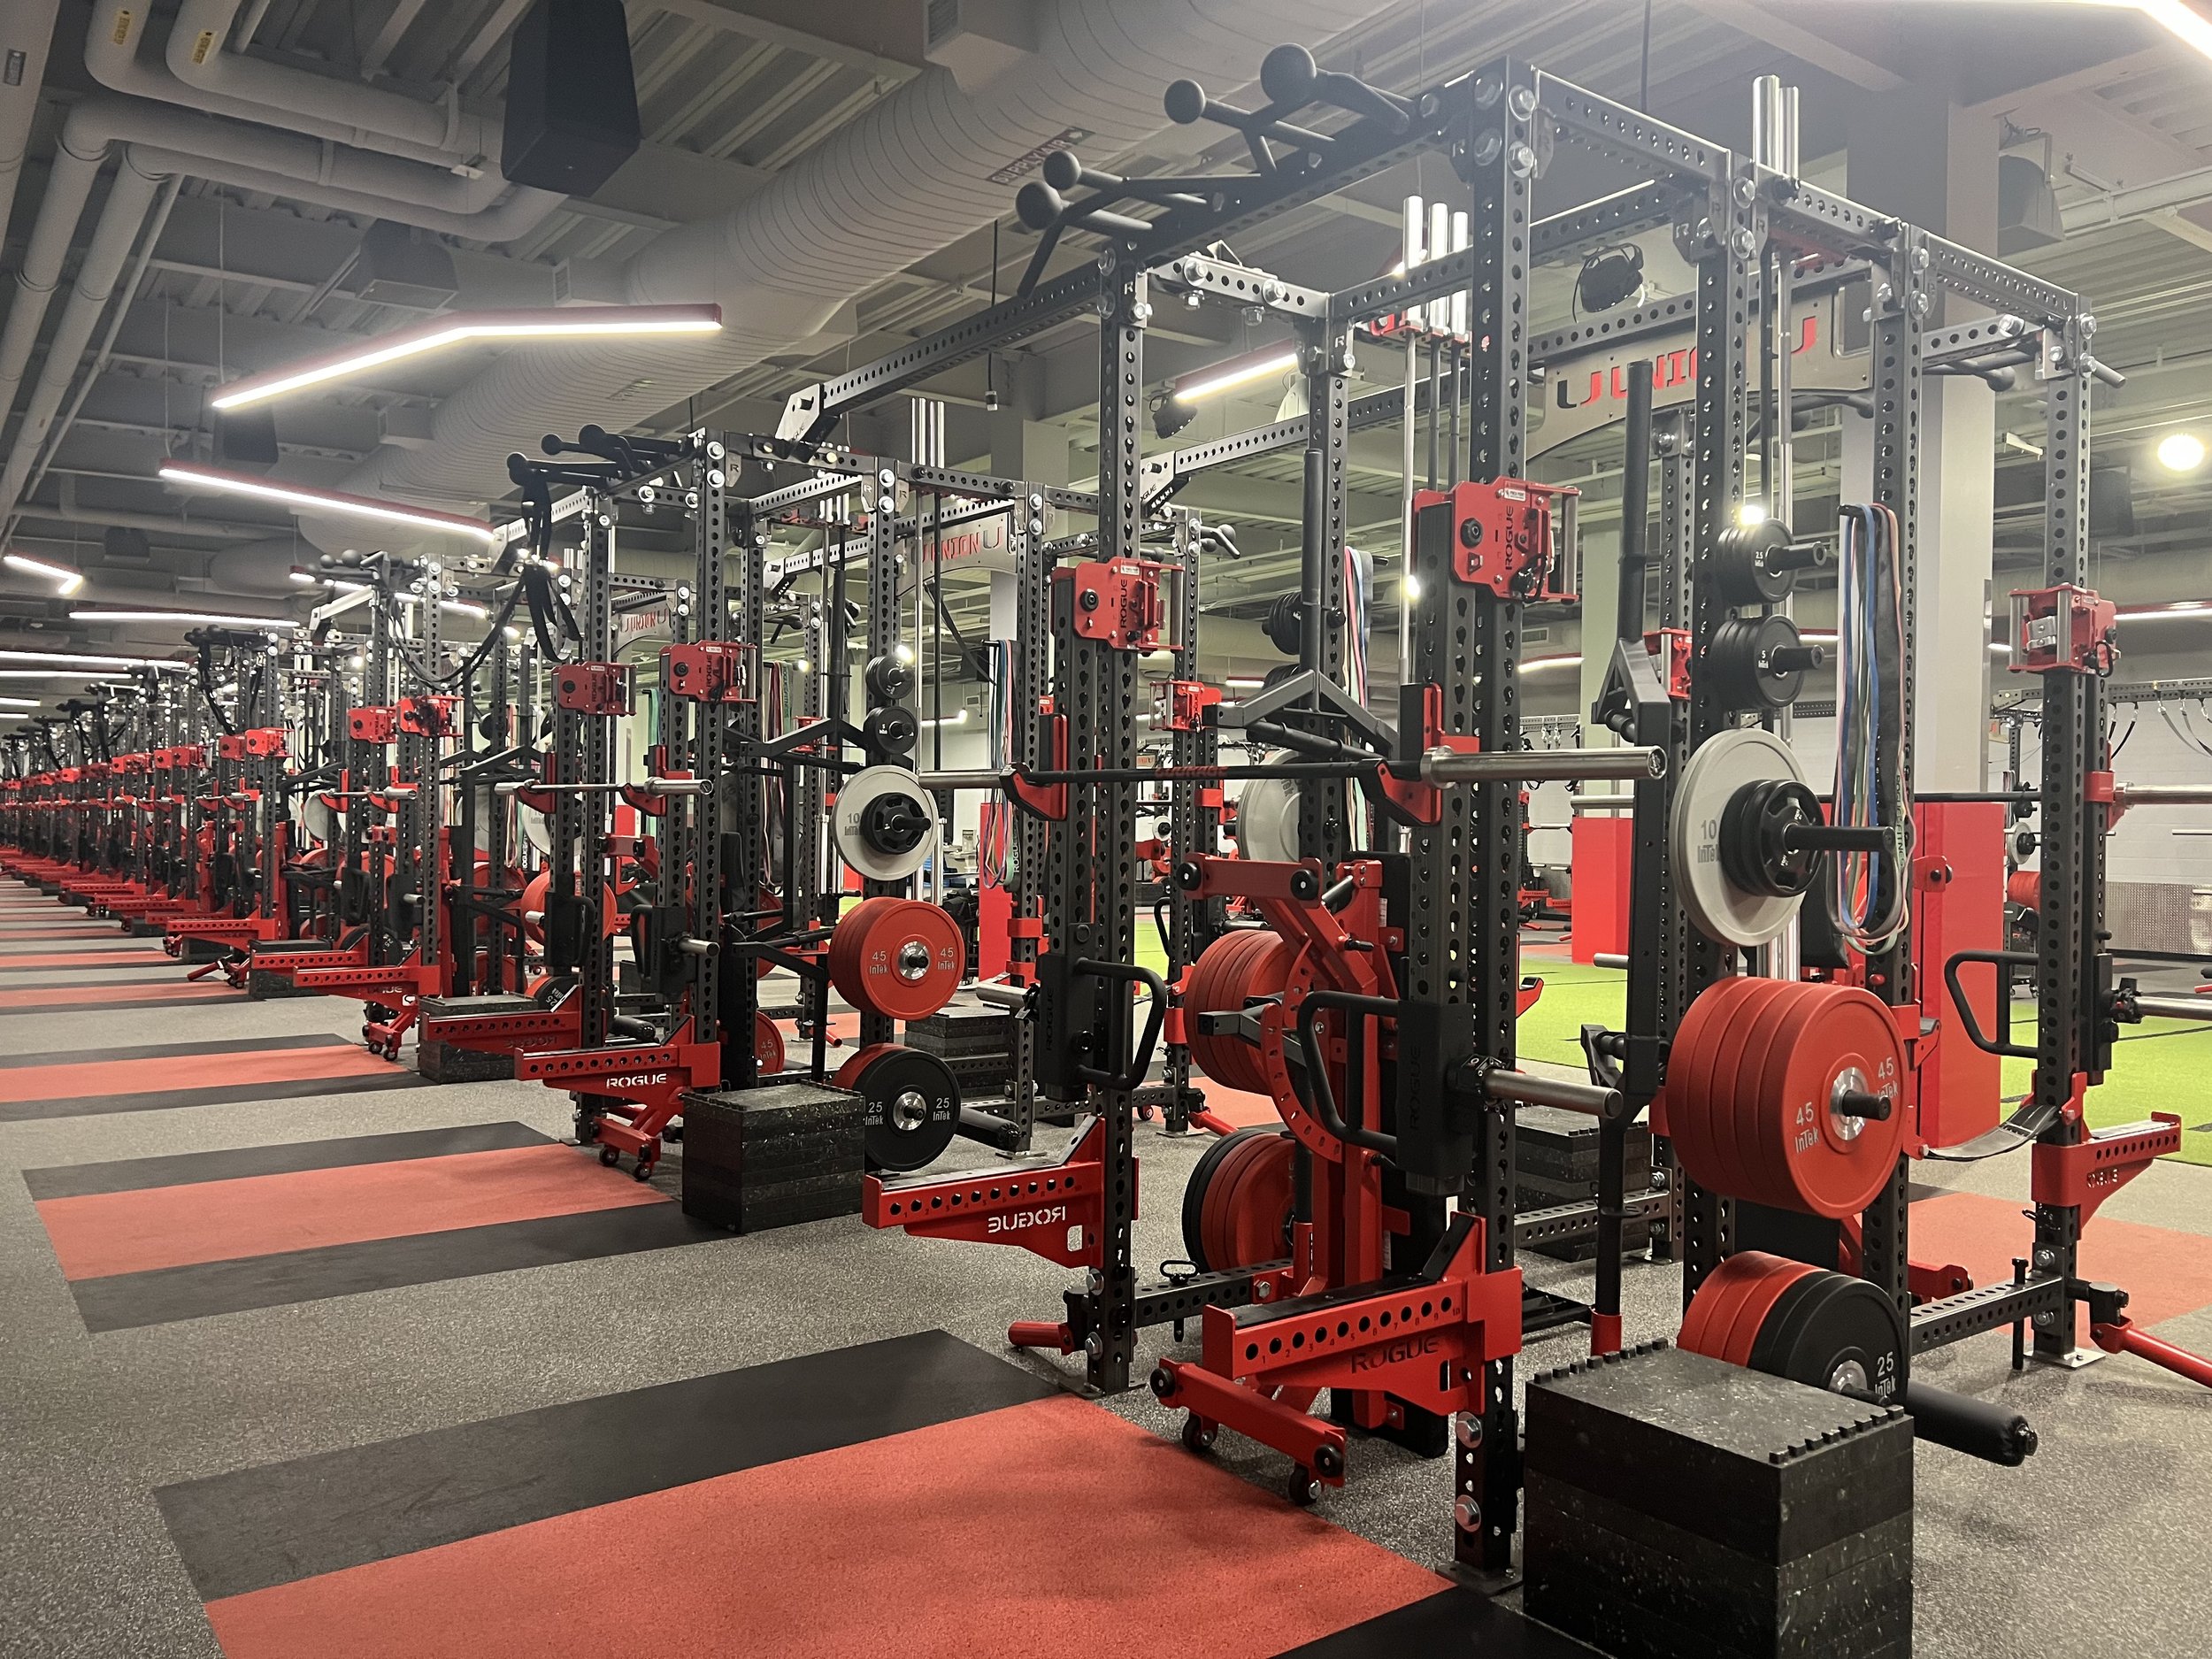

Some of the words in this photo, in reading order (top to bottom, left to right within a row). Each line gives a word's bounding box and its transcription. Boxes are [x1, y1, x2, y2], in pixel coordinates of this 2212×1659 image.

[991, 151, 1042, 183] SUPPLY
[1041, 139, 1075, 156] AIR
[1756, 219, 1765, 233] R
[1125, 281, 1133, 295] R
[1335, 336, 1344, 348] R
[730, 464, 739, 472] R
[864, 485, 872, 494] R
[899, 489, 907, 498] R
[1505, 505, 1514, 571] ROGUE
[930, 532, 980, 563] UNION
[848, 813, 860, 824] 10
[1701, 819, 1717, 840] 10
[872, 951, 887, 962] 45
[941, 948, 954, 958] 45
[869, 964, 888, 975] InTek
[938, 960, 956, 971] InTek
[761, 1039, 773, 1049] 45
[1878, 1057, 1894, 1079] 45
[606, 1072, 667, 1089] ROGUE
[1409, 1045, 1421, 1132] ROGUE
[868, 1102, 883, 1113] 25
[936, 1097, 950, 1109] 25
[1795, 1102, 1814, 1125] 45
[865, 1115, 884, 1125] InTek
[933, 1110, 951, 1121] InTek
[1794, 1126, 1819, 1154] InTek
[1309, 1343, 1313, 1352] 3
[1350, 1333, 1356, 1341] 5
[1433, 1312, 1439, 1321] 9
[1350, 1334, 1440, 1374] ROGUE
[1877, 1351, 1894, 1378] 25
[1875, 1375, 1896, 1398] InTek
